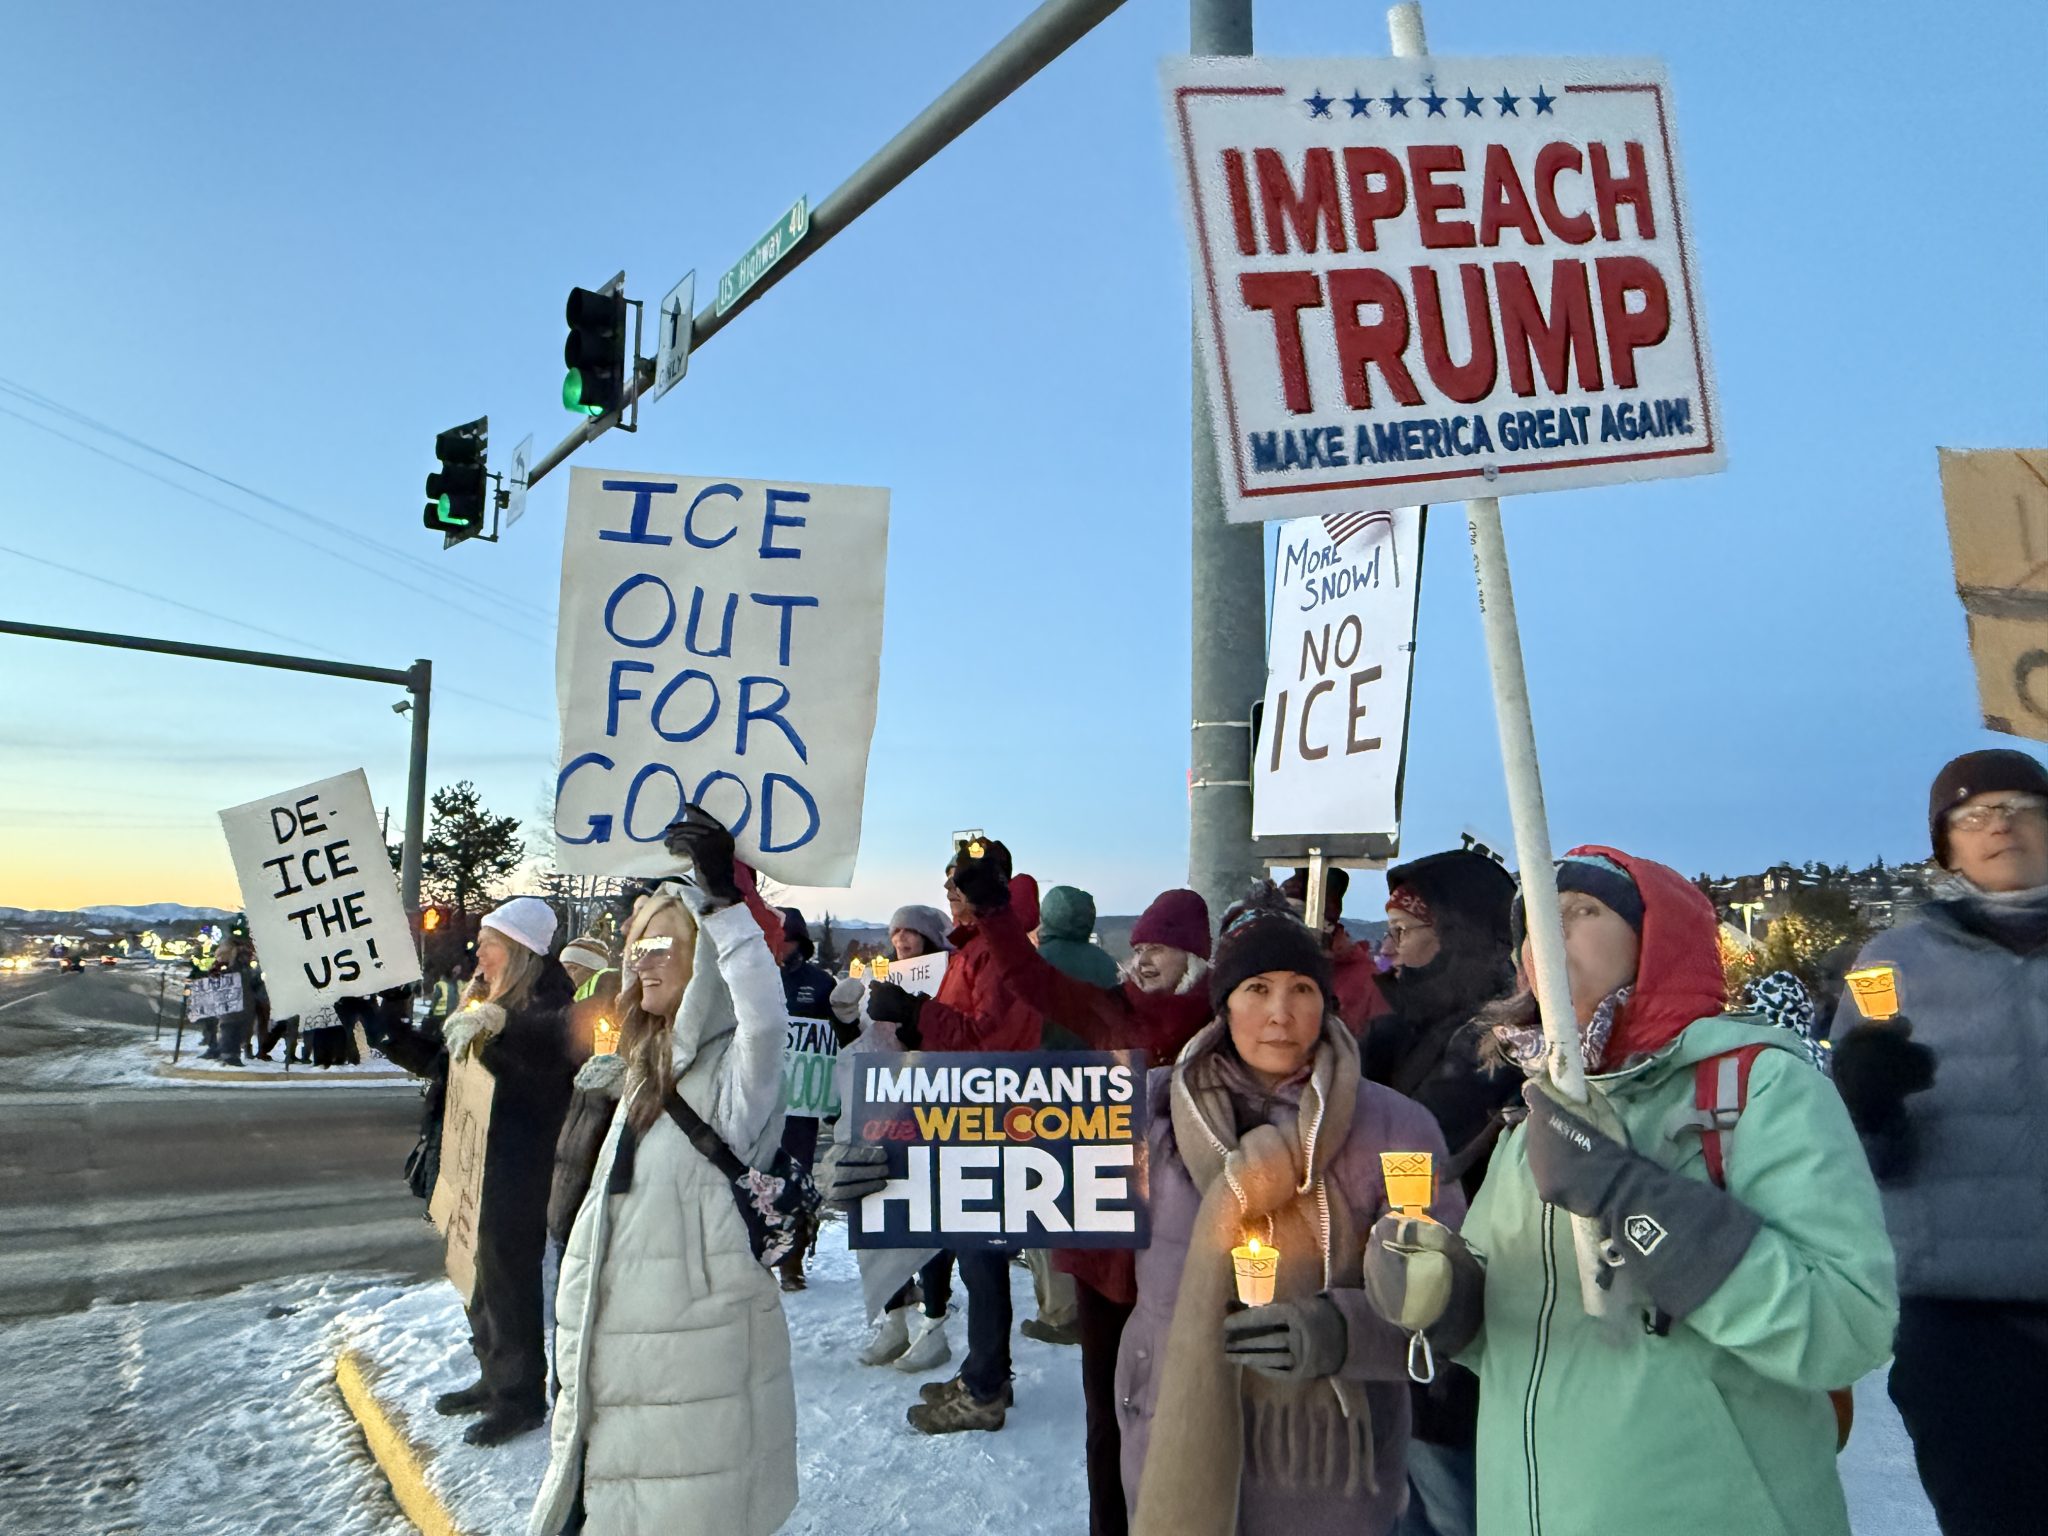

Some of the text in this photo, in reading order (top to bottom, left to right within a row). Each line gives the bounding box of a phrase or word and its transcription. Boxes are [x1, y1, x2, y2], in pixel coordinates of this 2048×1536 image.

[1221, 141, 1657, 255] IMPEACH
[721, 199, 804, 305] US Highway 40
[659, 352, 683, 388] ONLY
[1238, 256, 1671, 415] TRUMP
[1249, 398, 1695, 472] MAKE AMERICA GREAT AGAIN!
[599, 480, 811, 559] ICE
[1300, 546, 1381, 612] SNOW!
[604, 573, 819, 666] OUT
[1299, 614, 1363, 681] NO
[606, 660, 808, 765] FOR
[1270, 664, 1382, 773] ICE
[554, 752, 820, 852] GOOD
[262, 839, 359, 898] ICE
[288, 890, 372, 940] THE
[909, 964, 931, 982] THE
[865, 1065, 1133, 1103] IMMIGRANTS
[862, 1106, 1132, 1142] are WELCOME
[861, 1145, 1135, 1233] HERE
